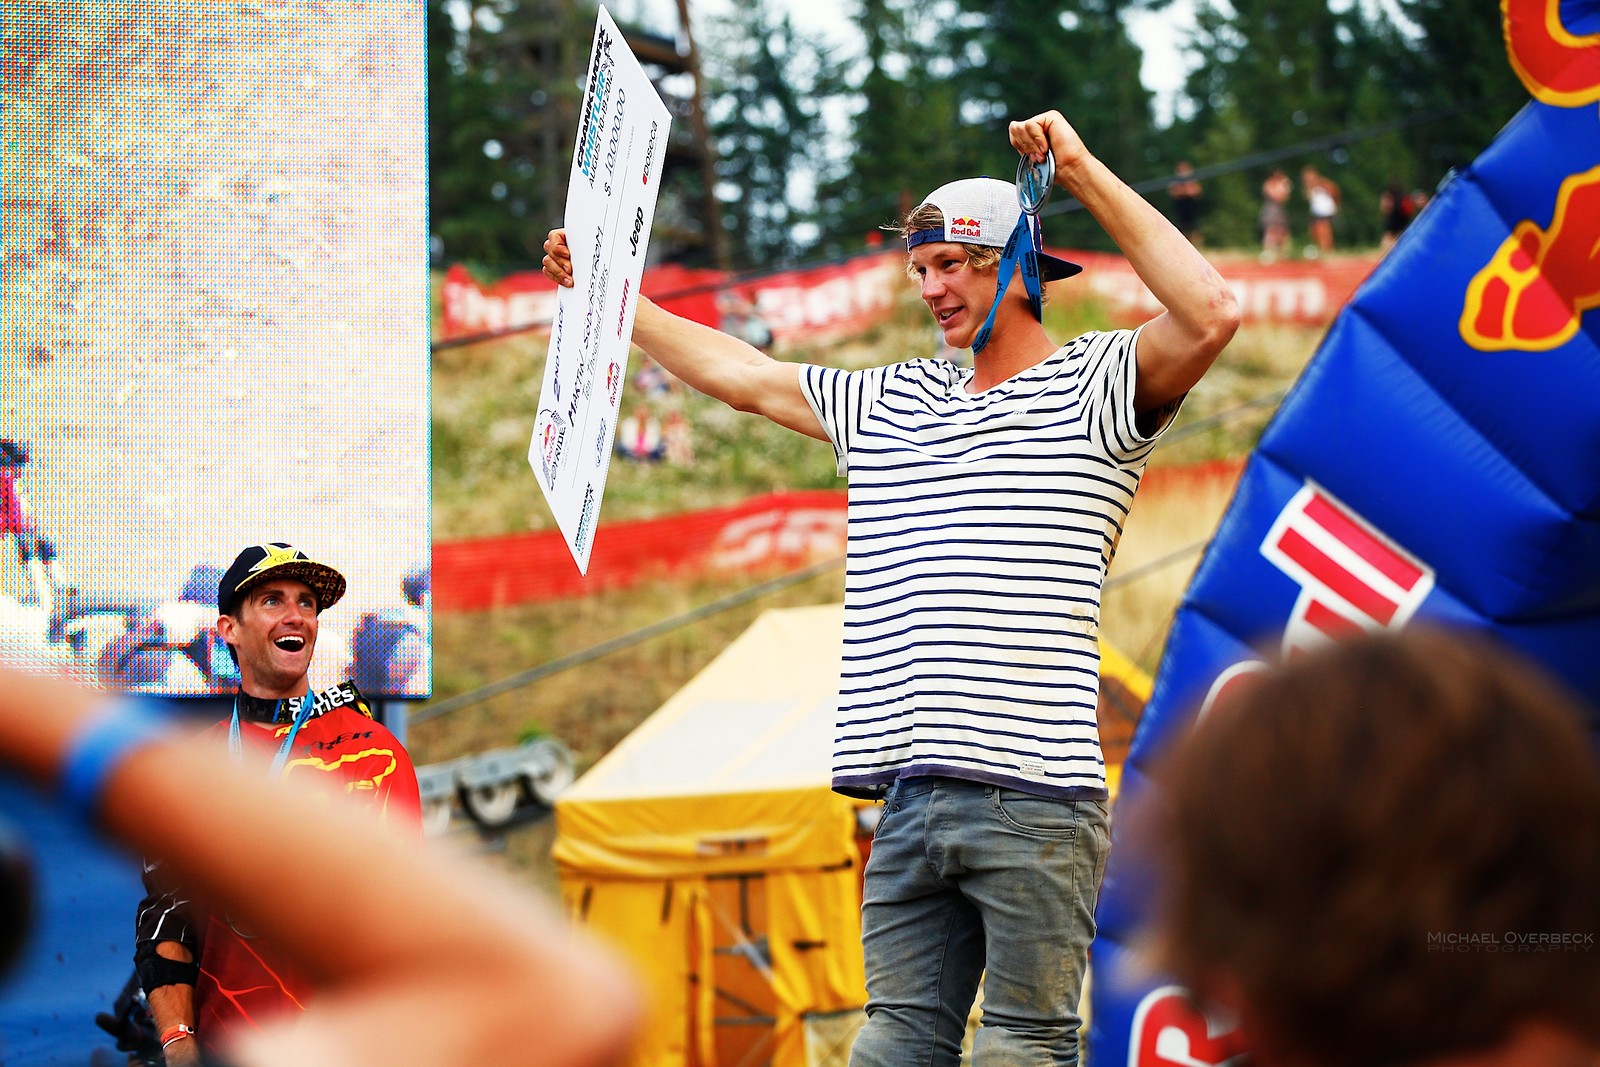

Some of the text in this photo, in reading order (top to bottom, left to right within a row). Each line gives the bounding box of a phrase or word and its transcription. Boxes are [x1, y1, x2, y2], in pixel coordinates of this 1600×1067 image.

[577, 24, 606, 168] CRANKWORX
[582, 70, 605, 177] WHISTLER
[589, 135, 602, 189] AUGUST
[604, 69, 614, 101] 2012
[628, 206, 644, 257] Jeep
[950, 227, 981, 238] Red Bull
